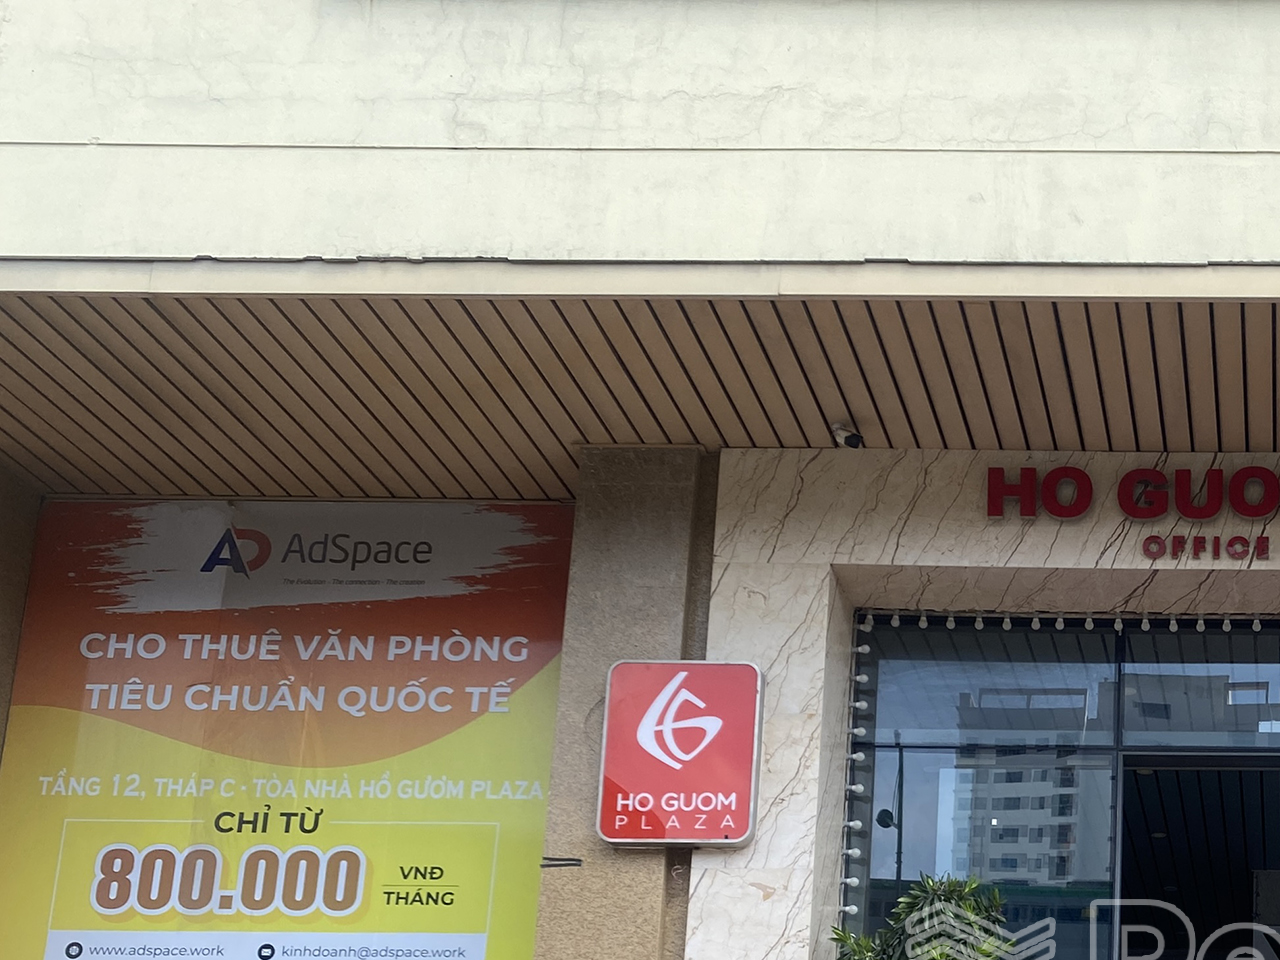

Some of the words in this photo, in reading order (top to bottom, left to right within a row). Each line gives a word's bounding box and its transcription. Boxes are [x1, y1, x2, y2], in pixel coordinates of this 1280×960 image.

[987, 466, 1093, 518] HO
[280, 533, 433, 571] AdSpace
[1142, 536, 1269, 560] OFFICE
[80, 633, 167, 660] CHO
[178, 628, 282, 660] THUÊ
[294, 629, 375, 661] VĂN
[387, 629, 529, 662] PHÒNG
[85, 677, 173, 710] TIÊU
[184, 676, 325, 712] CHUẨN
[337, 677, 454, 717] QUỐC
[465, 678, 516, 713] TẾ
[39, 768, 101, 795] TẦNG
[112, 774, 146, 800] 12,
[154, 773, 214, 797] THÁP
[219, 779, 236, 797] C
[252, 774, 297, 798] TÒA
[304, 774, 351, 798] NHÀ
[359, 771, 392, 798] HỒ
[397, 775, 463, 799] GƯƠM
[471, 780, 544, 800] PLAZA
[617, 792, 654, 812] HO
[660, 791, 737, 812] GUOM
[214, 804, 271, 834] CHỈ
[279, 806, 324, 834] TỪ
[615, 815, 735, 829] PLAZA
[92, 846, 365, 911] 800.000
[399, 865, 444, 881] VNĐ
[383, 889, 455, 906] THÁNG
[89, 945, 224, 958] www.adspace.work
[282, 946, 466, 960] kinhdoanh@adspace.work
